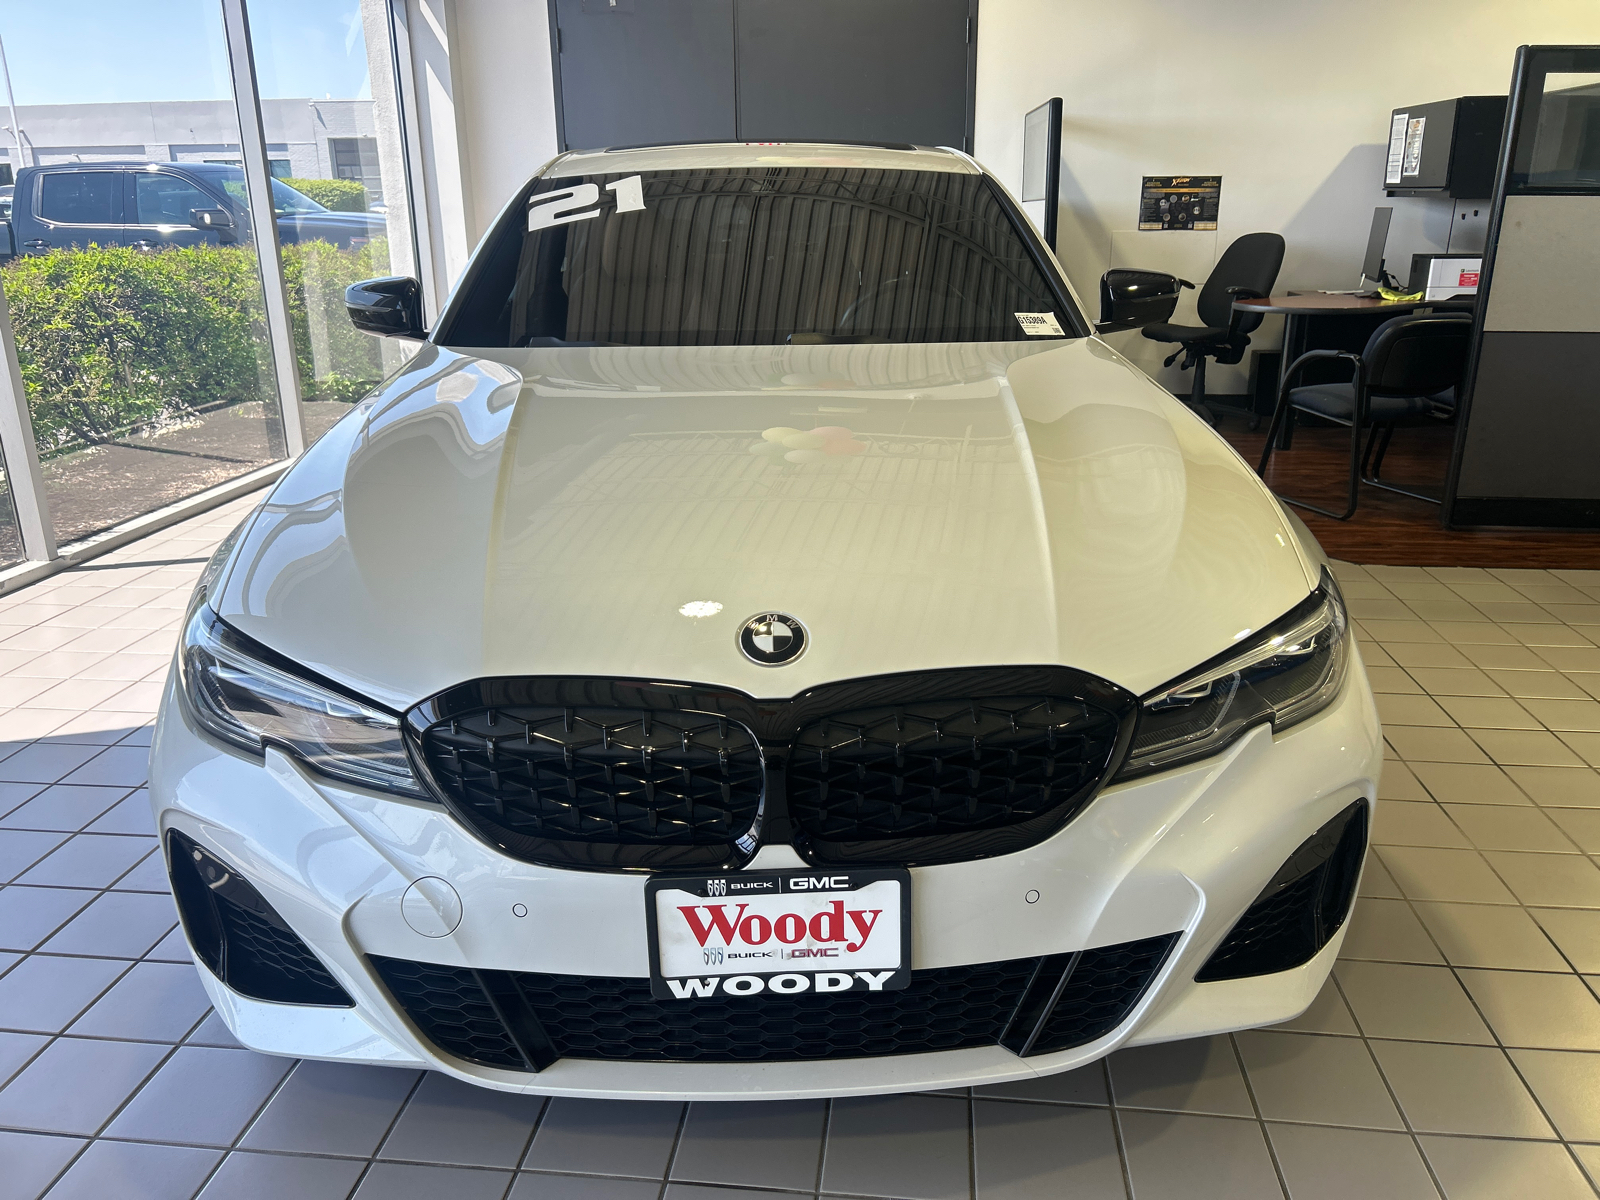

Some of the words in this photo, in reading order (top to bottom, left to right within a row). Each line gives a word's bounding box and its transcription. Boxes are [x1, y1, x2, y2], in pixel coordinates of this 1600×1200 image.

[529, 175, 646, 232] 21
[748, 615, 799, 629] BMW
[790, 876, 849, 889] GMC
[677, 900, 882, 952] Woody
[791, 948, 839, 957] GMC
[666, 971, 896, 998] WOODY
